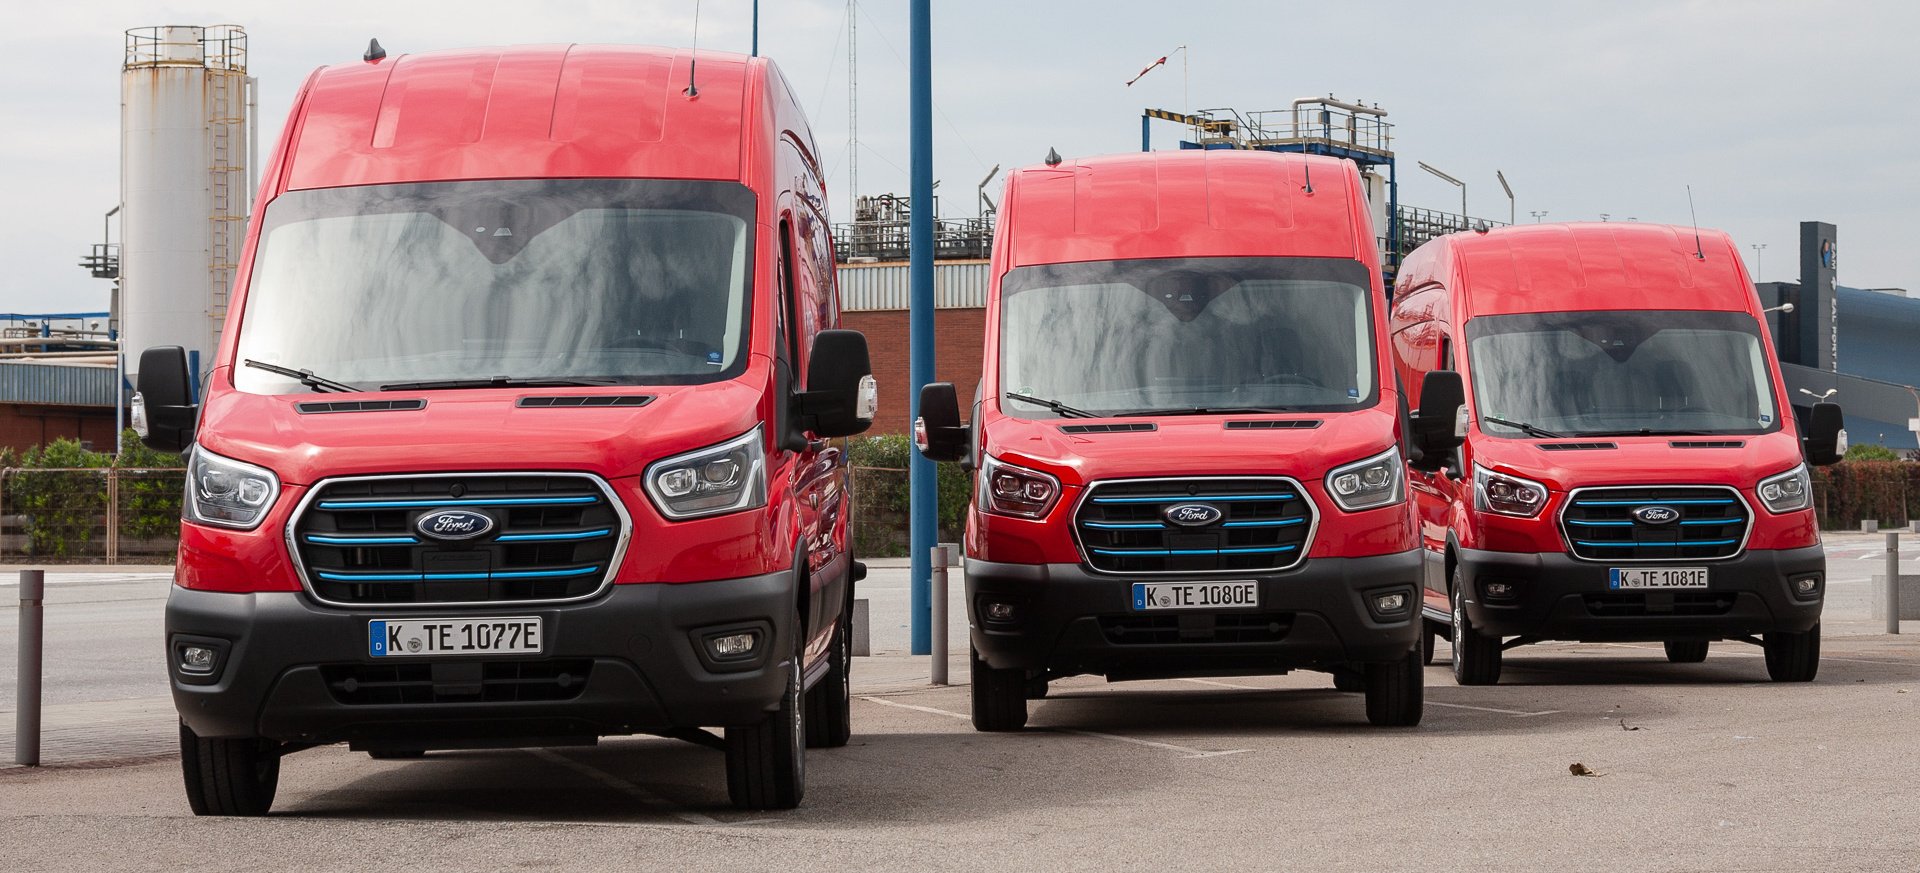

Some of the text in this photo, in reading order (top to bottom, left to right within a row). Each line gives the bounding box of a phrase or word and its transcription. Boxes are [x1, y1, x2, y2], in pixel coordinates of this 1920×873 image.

[1179, 507, 1209, 520] Ford
[1645, 509, 1670, 520] Ford
[433, 514, 475, 532] Ford
[1620, 570, 1707, 587] K TE 1081E
[1146, 585, 1256, 607] K TE 1080E
[388, 625, 404, 652] K
[422, 624, 455, 651] TE
[460, 622, 539, 650] 1077E
[375, 642, 383, 651] D
